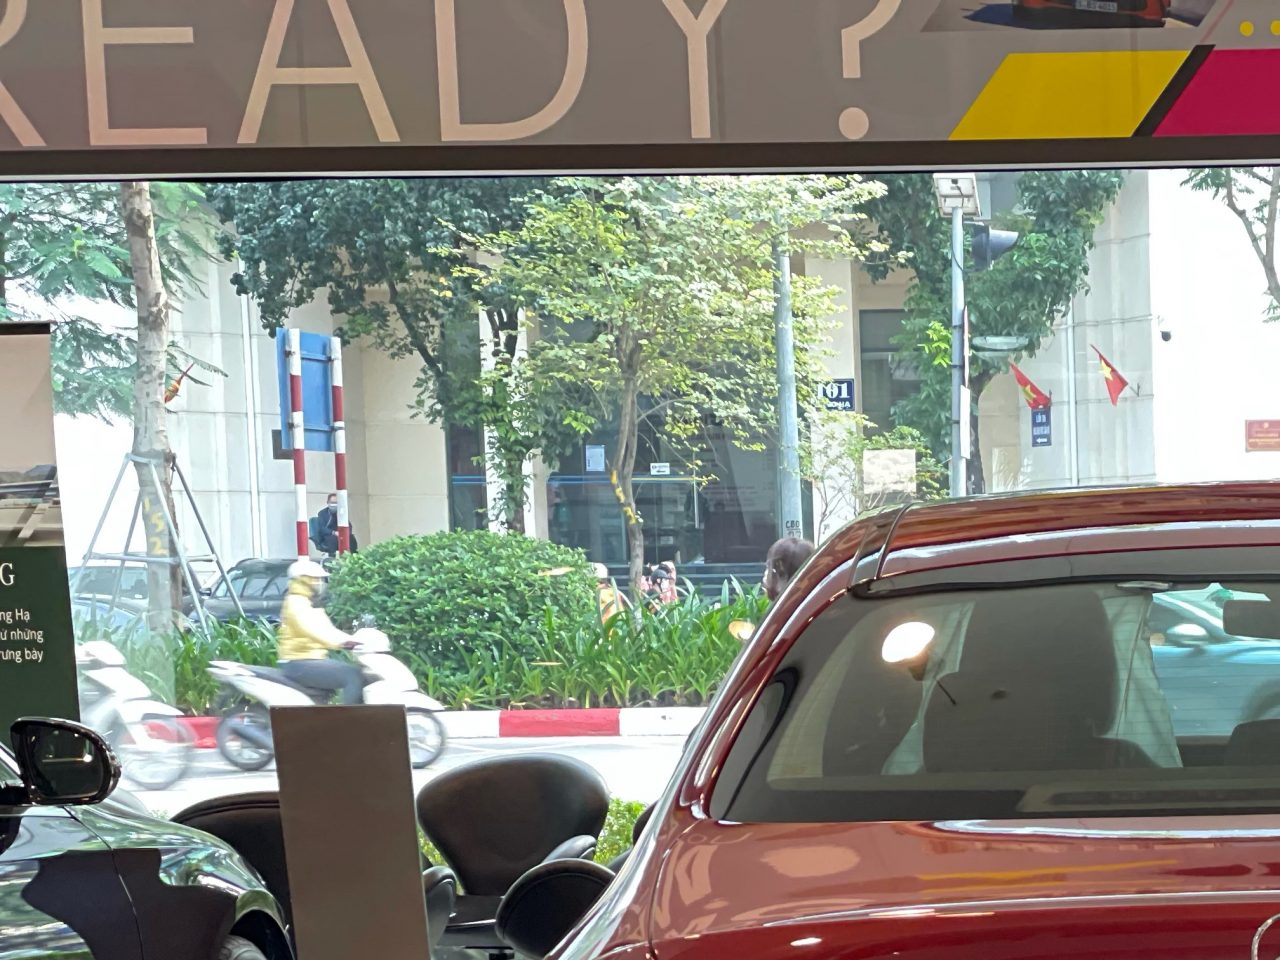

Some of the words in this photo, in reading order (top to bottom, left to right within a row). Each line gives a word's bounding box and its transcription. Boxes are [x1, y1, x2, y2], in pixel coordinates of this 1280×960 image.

[15, 608, 31, 623] Hạ
[10, 627, 44, 643] những
[24, 647, 44, 663] bày
